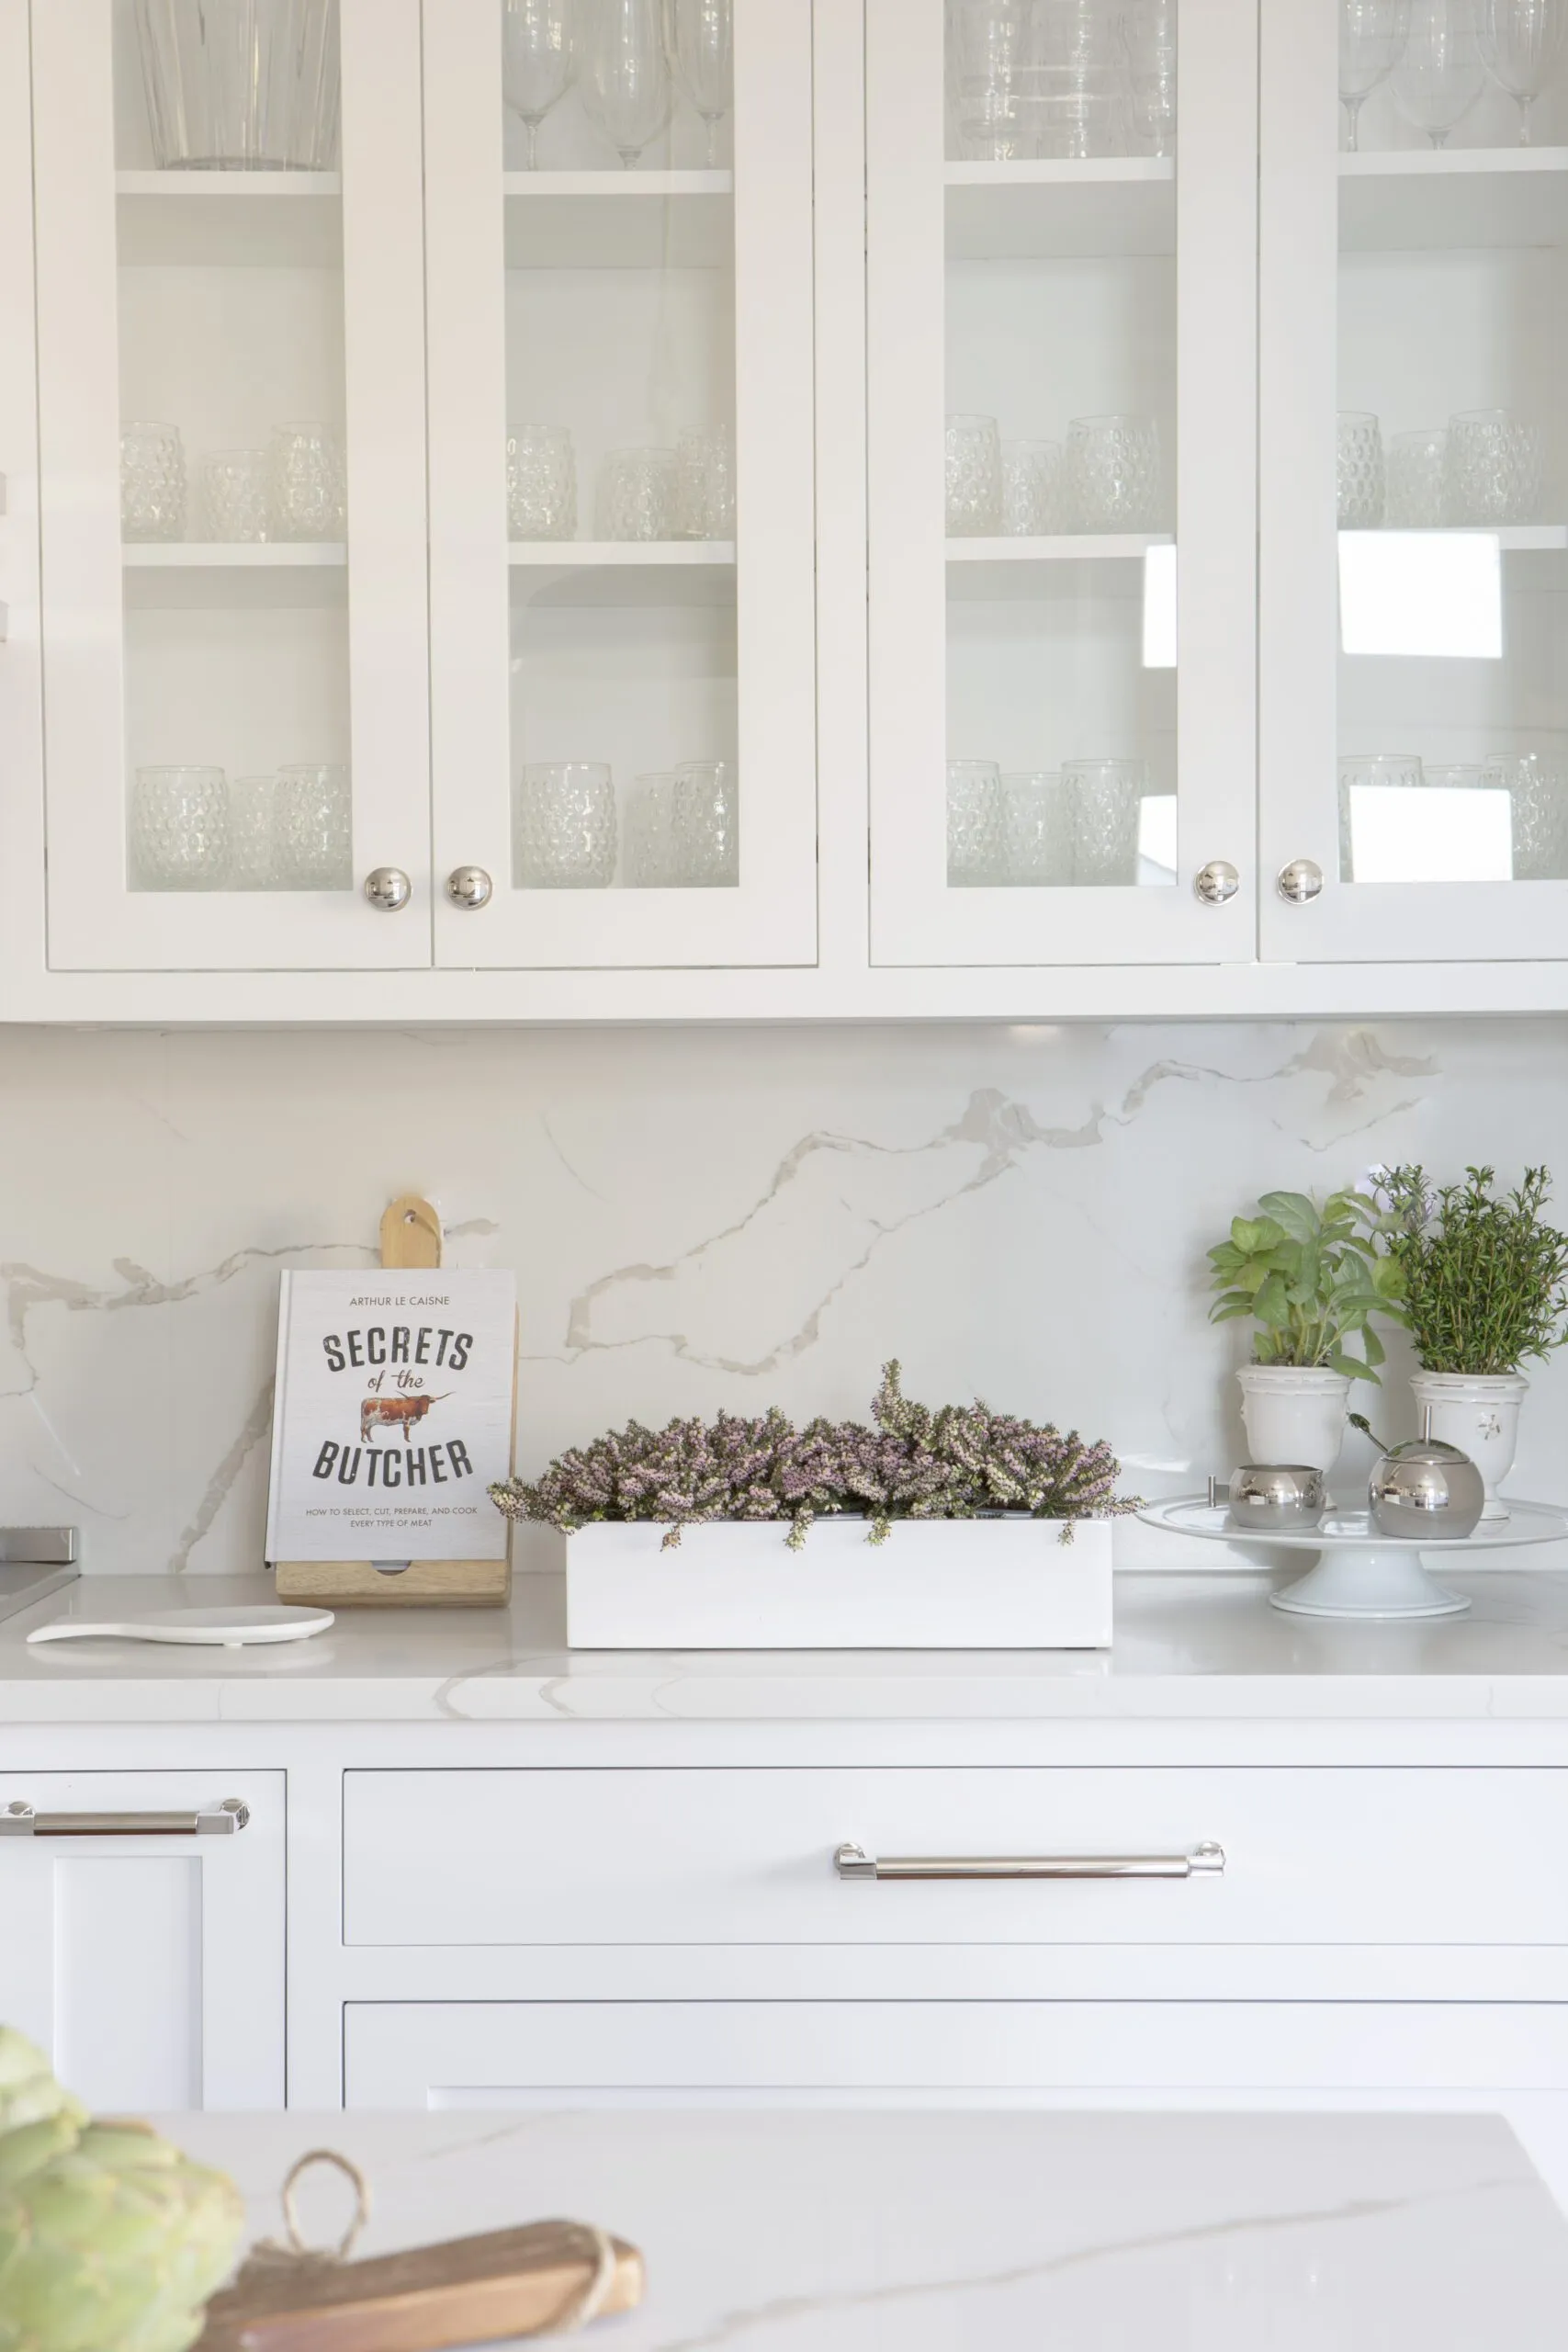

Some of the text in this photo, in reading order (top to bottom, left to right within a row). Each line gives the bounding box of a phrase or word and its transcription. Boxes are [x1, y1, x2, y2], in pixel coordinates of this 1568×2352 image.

[349, 1295, 450, 1306] ARTHUR LE CAISNE
[322, 1326, 474, 1372] SECRETS
[367, 1369, 426, 1393] of the
[312, 1439, 474, 1487] BUTCHER
[343, 1508, 372, 1516] SELECT,
[374, 1508, 391, 1516] CUT,
[393, 1508, 429, 1516] PREPARE,
[431, 1507, 450, 1515] AND
[452, 1507, 478, 1515] COOK
[350, 1520, 375, 1528] EVERY
[376, 1520, 395, 1528] TYPE
[410, 1519, 433, 1527] MEAT
